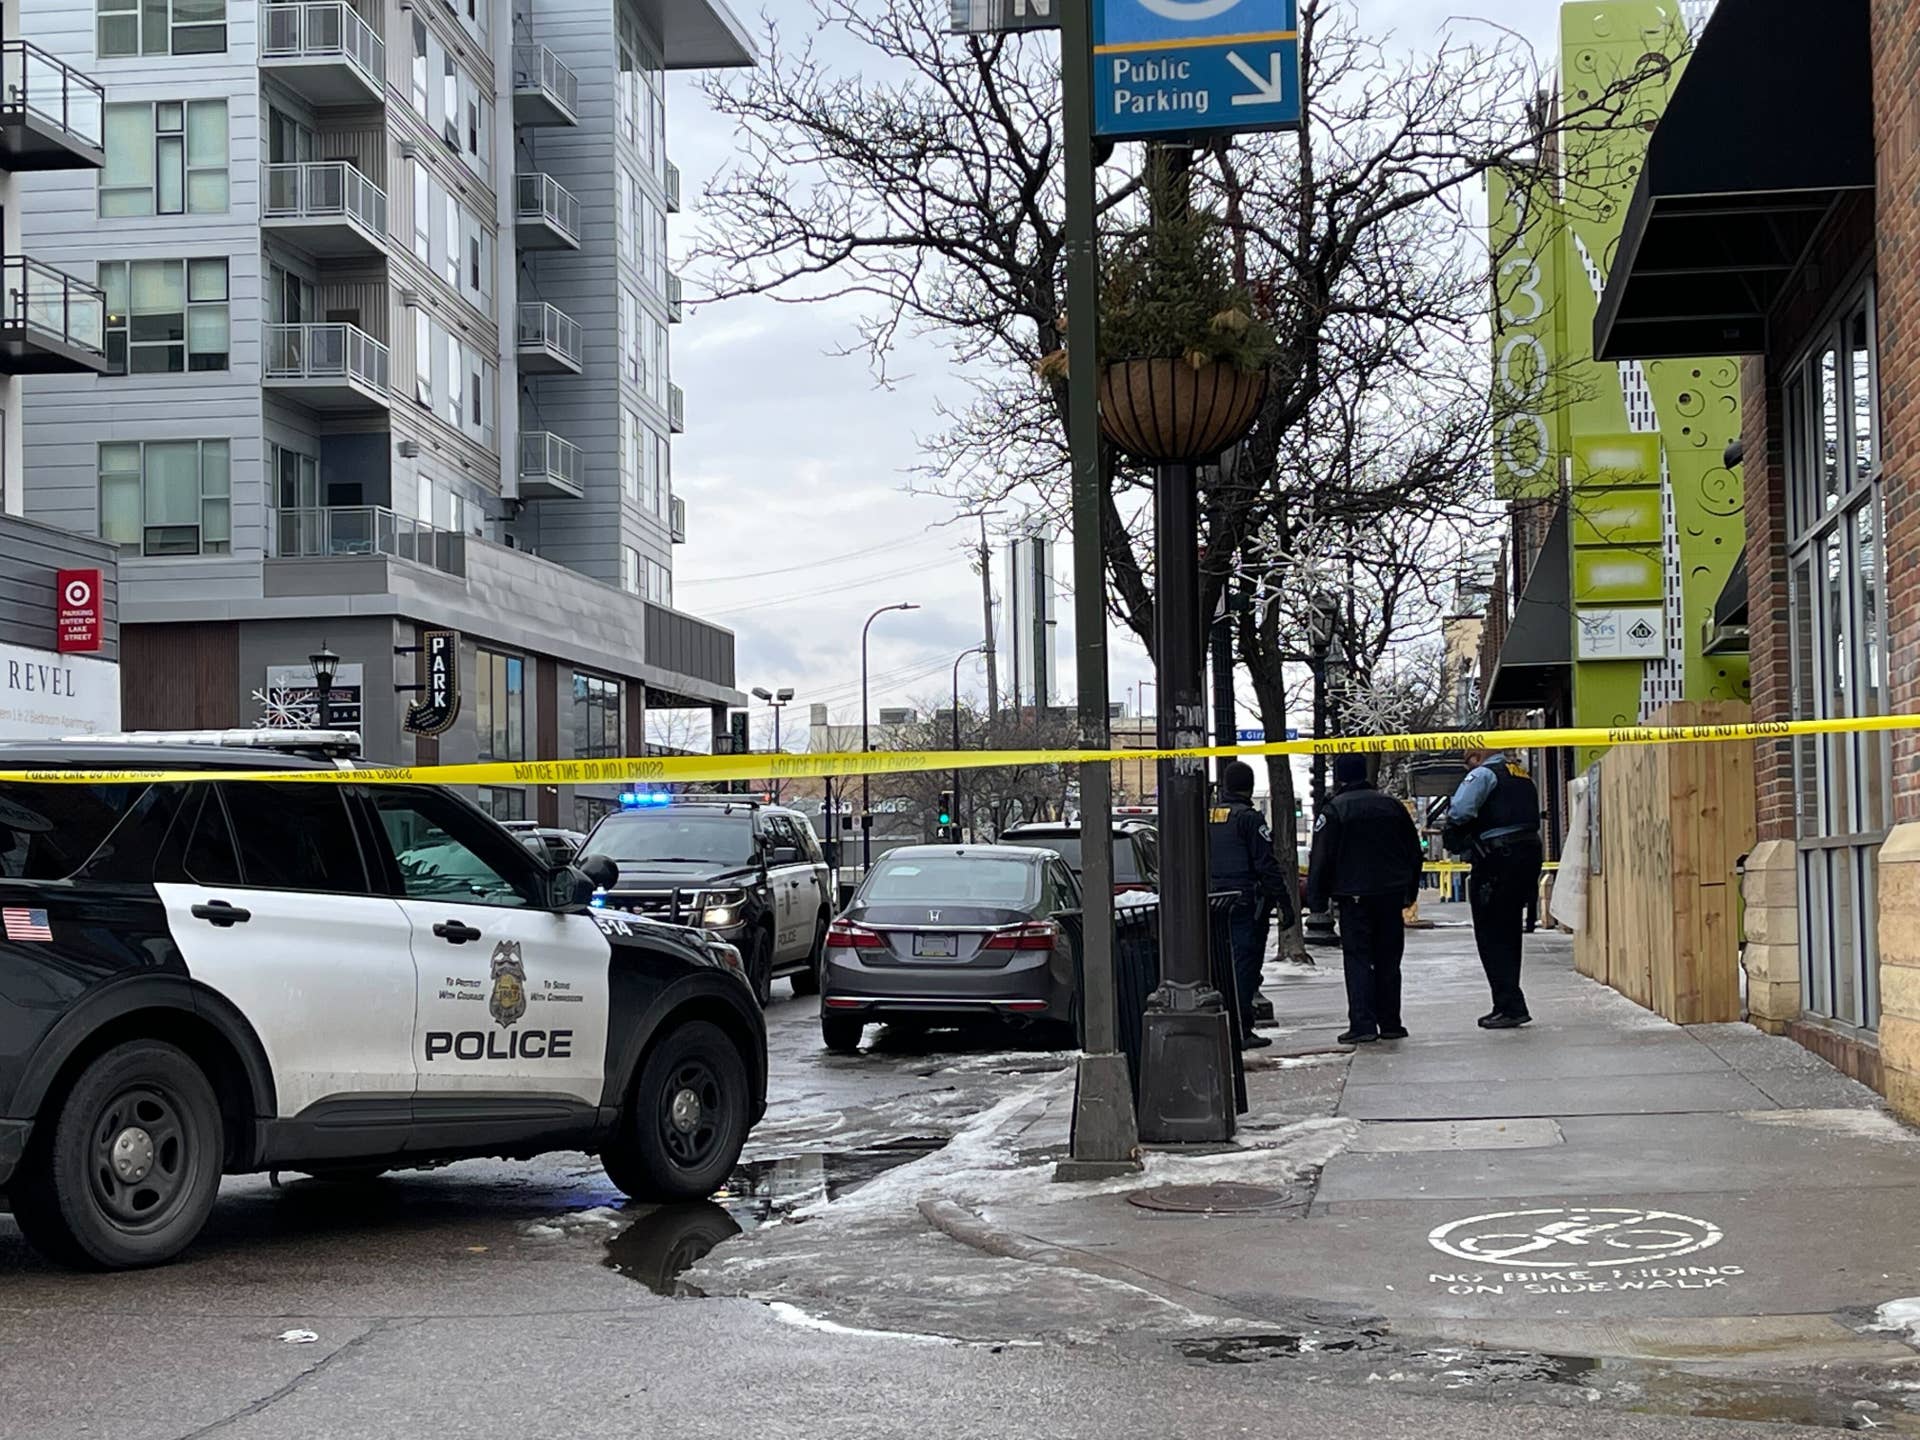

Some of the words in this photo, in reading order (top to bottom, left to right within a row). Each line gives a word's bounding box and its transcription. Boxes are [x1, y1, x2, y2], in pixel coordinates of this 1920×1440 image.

[1113, 58, 1190, 84] Public
[1113, 88, 1209, 115] Parking
[62, 609, 94, 617] PARKING
[64, 633, 92, 641] STREET
[68, 625, 87, 633] LAKE
[8, 659, 76, 697] REVEL
[432, 637, 447, 708] PARK
[1607, 729, 1654, 742] POLICE
[1659, 728, 1687, 741] LINE
[1693, 726, 1710, 738] DO
[1714, 725, 1740, 737] NOT
[1745, 721, 1790, 735] CROSS
[1313, 742, 1357, 754] POLICE
[1361, 740, 1388, 752] LINE
[1393, 738, 1411, 752] DO
[1414, 737, 1438, 751] NOT
[1442, 735, 1486, 750] CROSS
[595, 919, 634, 936] 514
[425, 1030, 573, 1061] POLICE
[1429, 1273, 1483, 1282] NO
[1503, 1271, 1593, 1282] BIKE
[1448, 1285, 1504, 1294] ON
